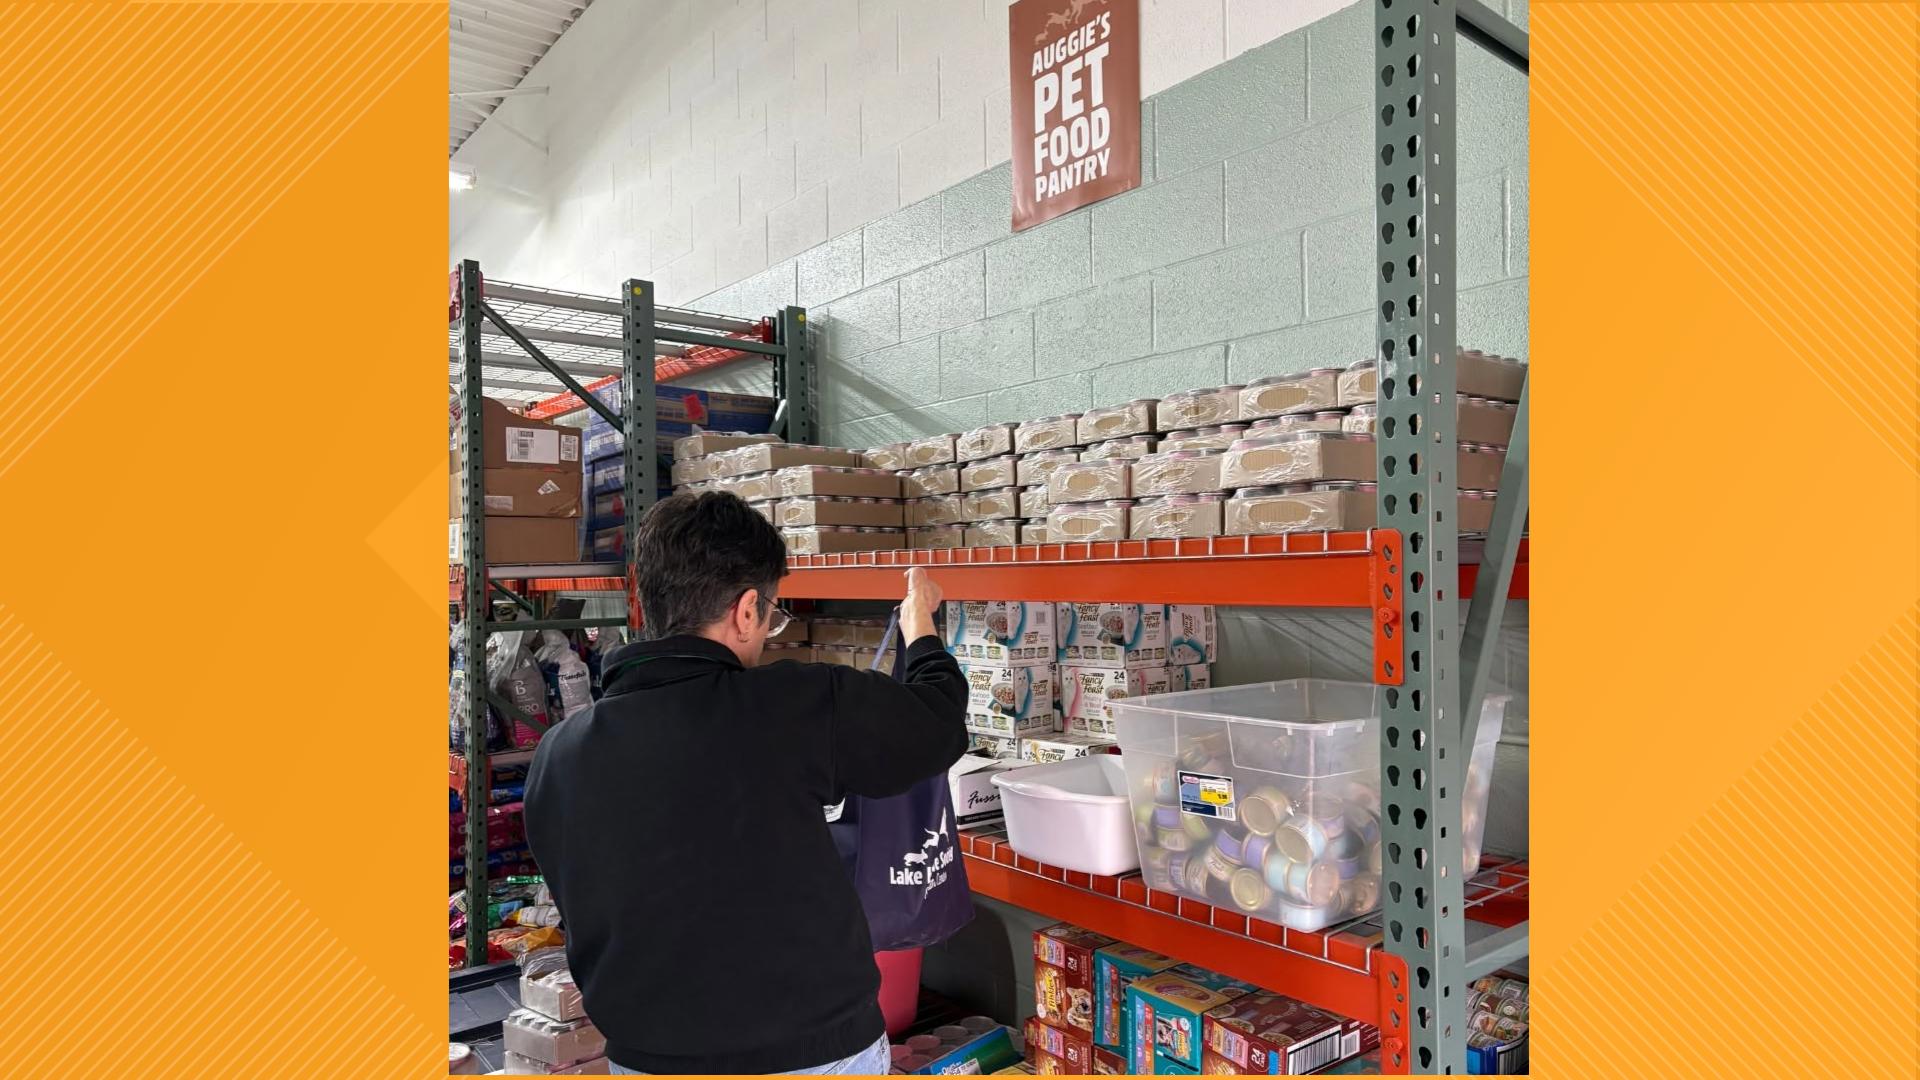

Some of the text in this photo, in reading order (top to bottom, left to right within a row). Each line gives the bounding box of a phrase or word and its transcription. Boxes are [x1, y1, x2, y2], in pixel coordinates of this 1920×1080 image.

[1031, 11, 1111, 77] AUGGIE'S
[1034, 41, 1110, 134] PET
[1034, 107, 1111, 174] FOOD
[1035, 148, 1111, 202] PANTRY
[1079, 613, 1099, 622] Feast
[969, 671, 992, 683] Fancy
[1001, 669, 1012, 677] 24
[1113, 671, 1125, 680] 24
[971, 681, 991, 691] Feast
[1080, 674, 1104, 686] Fancy
[1083, 684, 1104, 694] Feast
[1007, 738, 1016, 746] 24
[1038, 749, 1065, 761] Fancy
[1075, 748, 1086, 757] 24
[890, 867, 923, 885] Lake
[1251, 1047, 1261, 1065] 24
